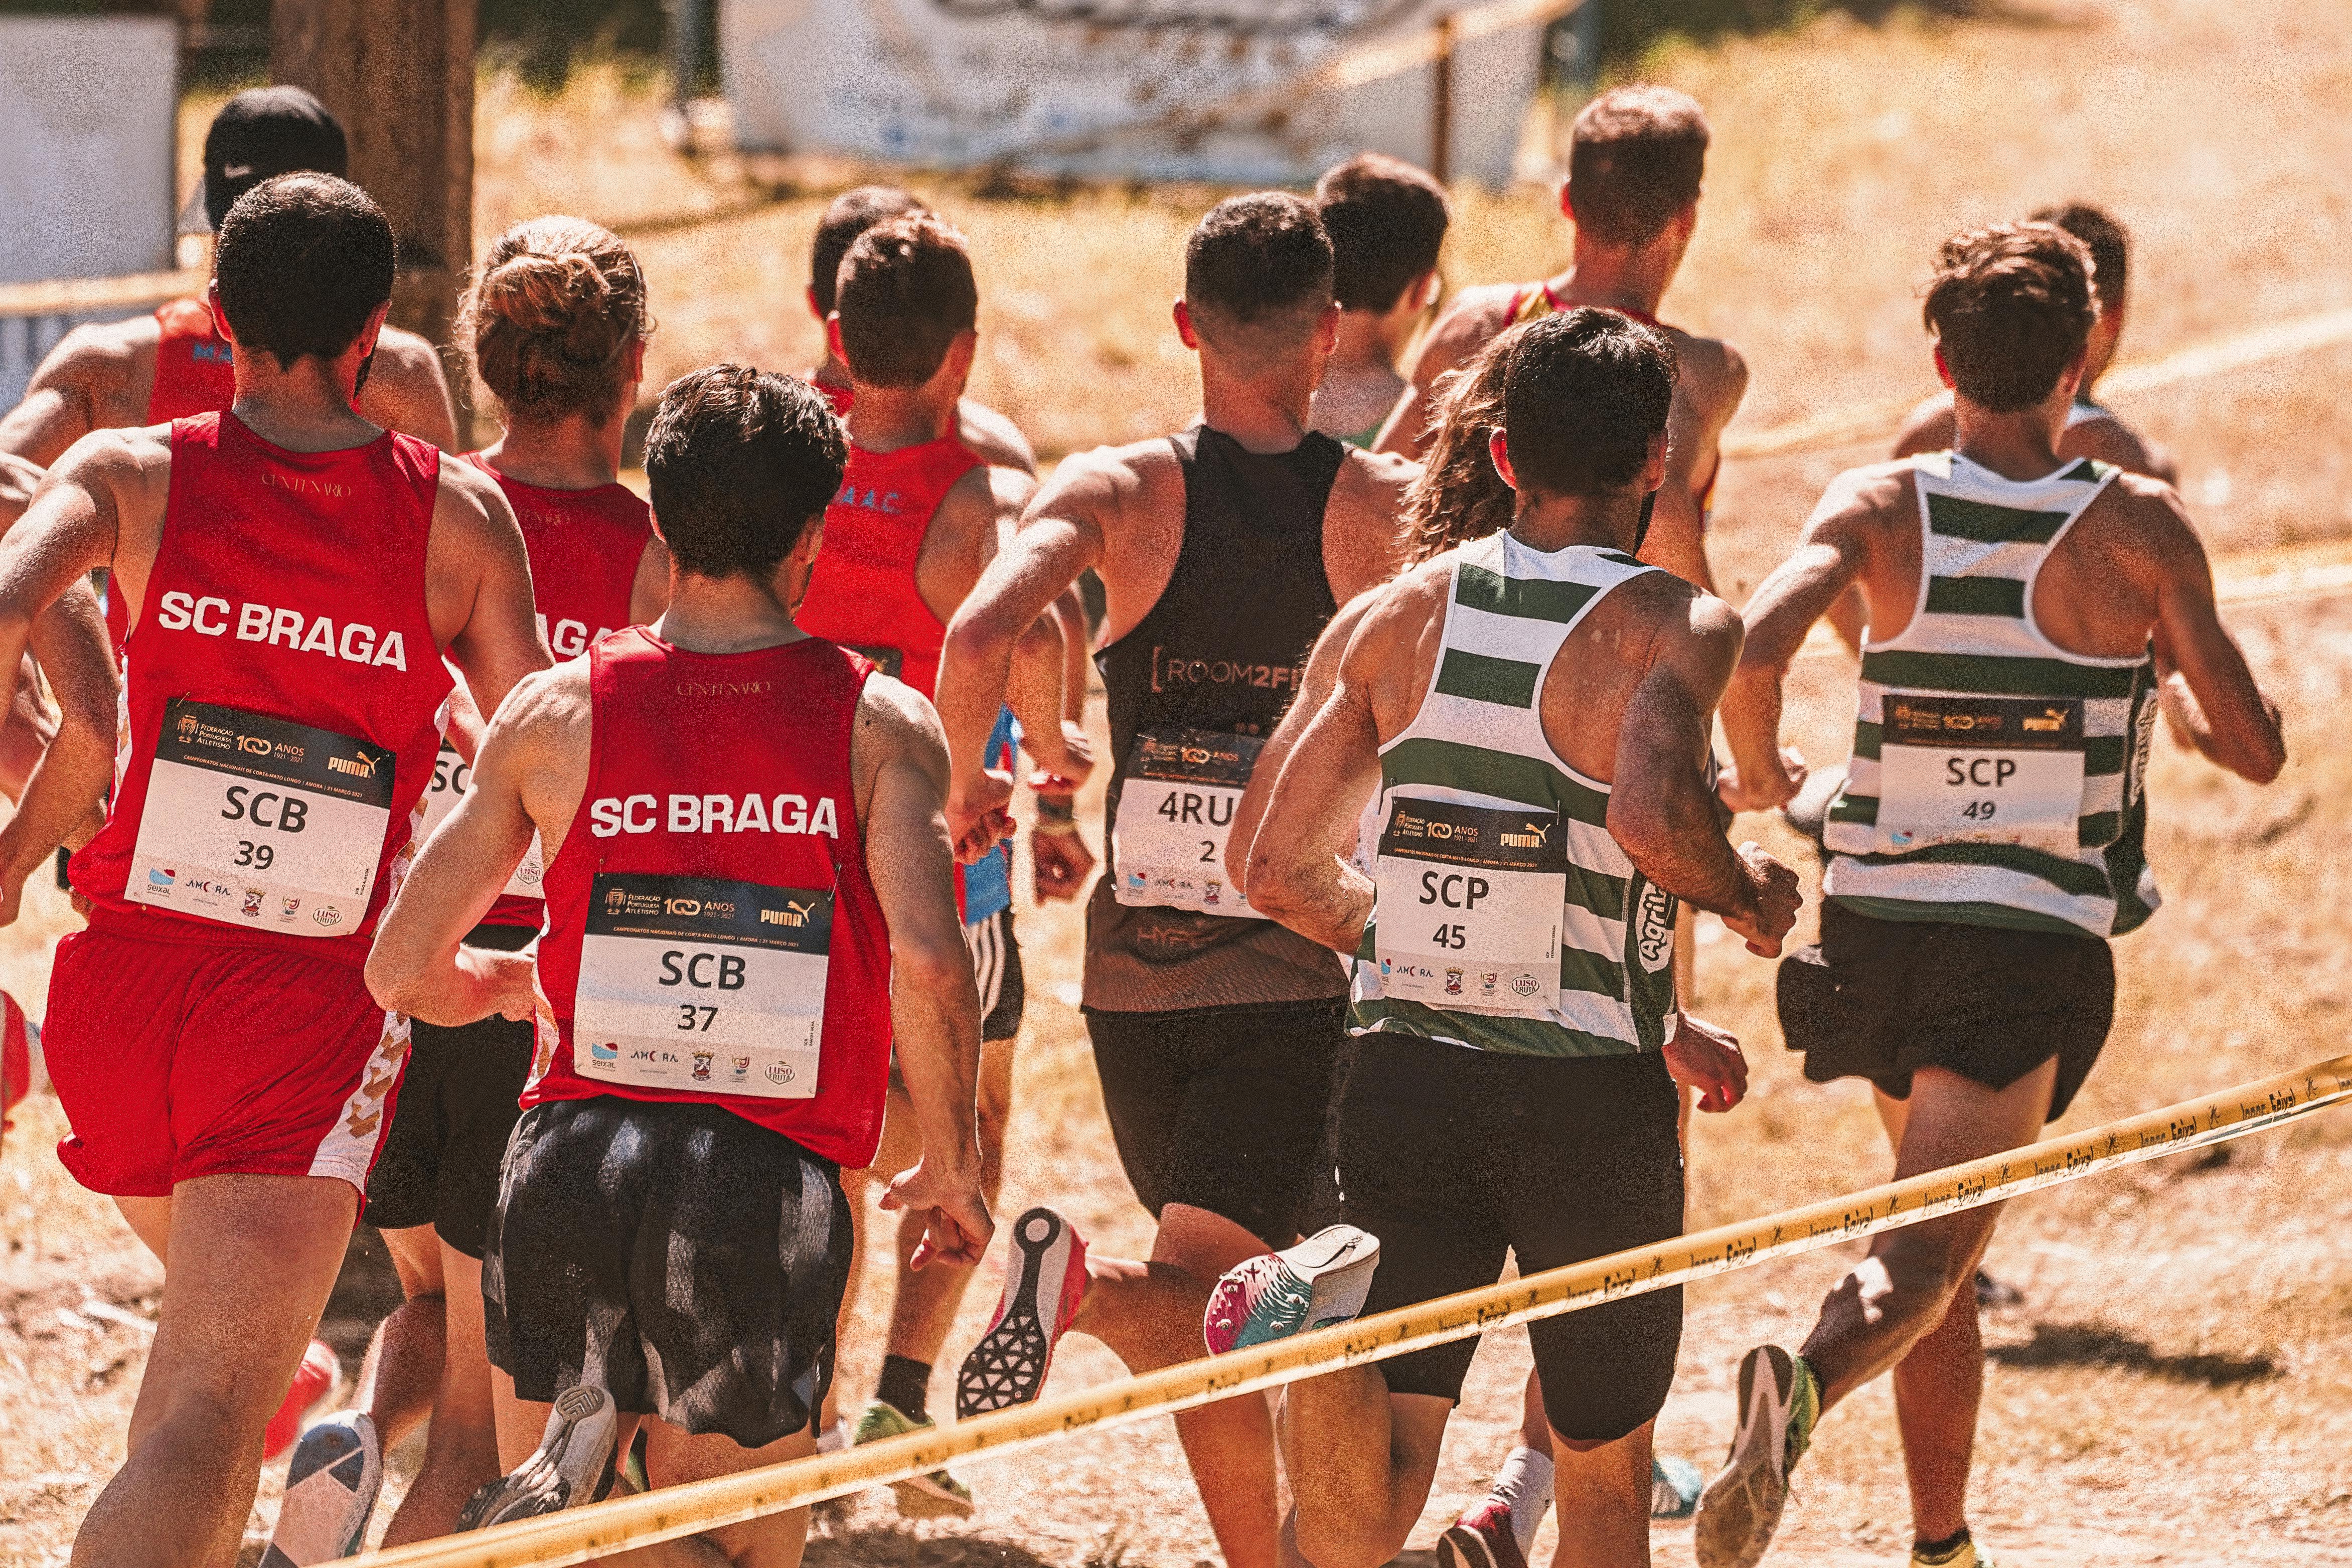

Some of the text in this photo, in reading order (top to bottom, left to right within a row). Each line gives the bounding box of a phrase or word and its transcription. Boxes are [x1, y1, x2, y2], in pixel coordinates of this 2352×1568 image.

[159, 590, 407, 672] SC BRAGA
[197, 738, 231, 750] ATLETISMO
[236, 735, 304, 756] 100 ANOS
[328, 756, 370, 778] PUMA
[1946, 758, 2016, 788] SCP
[221, 786, 309, 833] SCB
[590, 793, 838, 839] SC BRAGA
[1963, 802, 1995, 820] 49
[1427, 822, 1478, 839] 100 ANOS
[1500, 833, 1540, 848] PUMA
[234, 841, 274, 870] 39
[1419, 871, 1489, 910] SCP
[625, 907, 659, 915] ATLETISMO
[664, 898, 735, 916] 100 ANOS
[760, 909, 802, 927] PUMA
[1433, 923, 1466, 950] 45
[1639, 887, 1667, 961] Agril
[658, 951, 746, 991] SCB
[677, 1004, 719, 1032] 37
